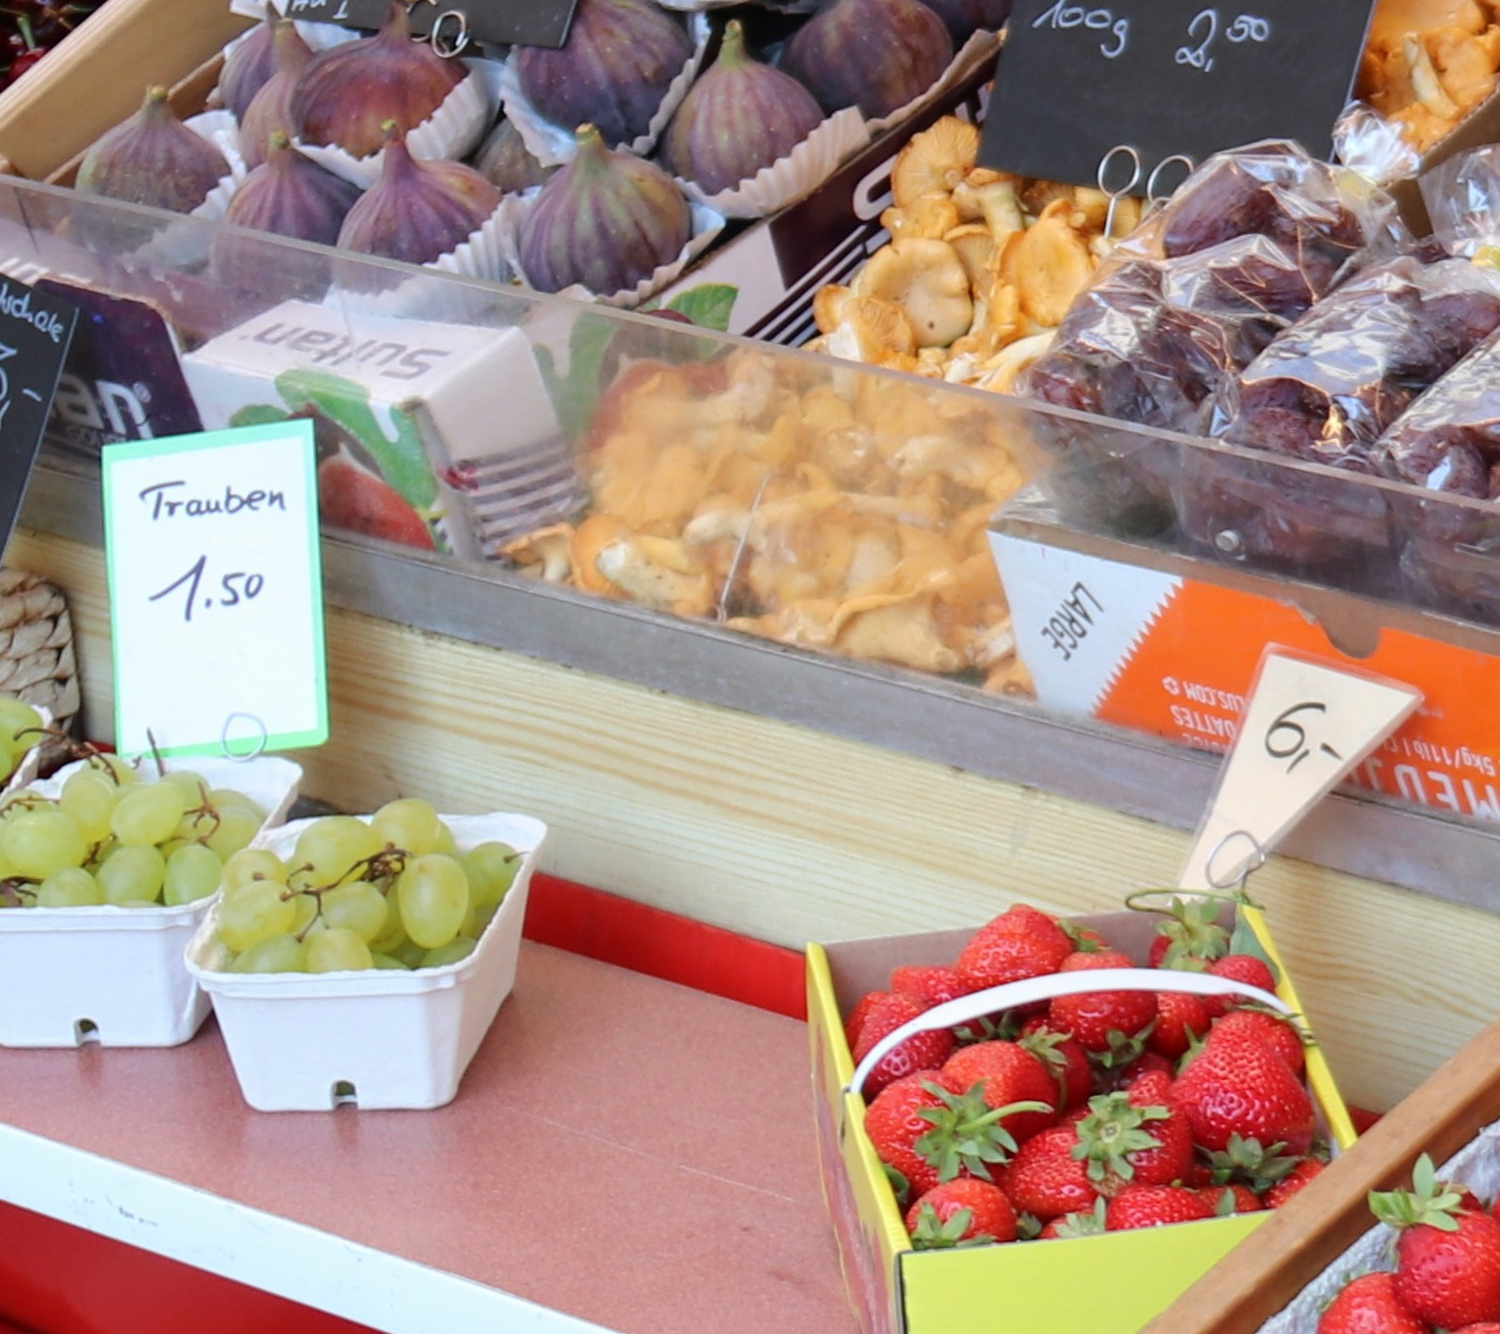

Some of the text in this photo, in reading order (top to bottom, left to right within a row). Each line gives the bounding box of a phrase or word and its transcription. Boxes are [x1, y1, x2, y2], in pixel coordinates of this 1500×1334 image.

[250, 321, 451, 381] Sultan
[138, 479, 287, 523] Trauben
[148, 554, 265, 623] 1.50
[1040, 581, 1105, 662] LARGE
